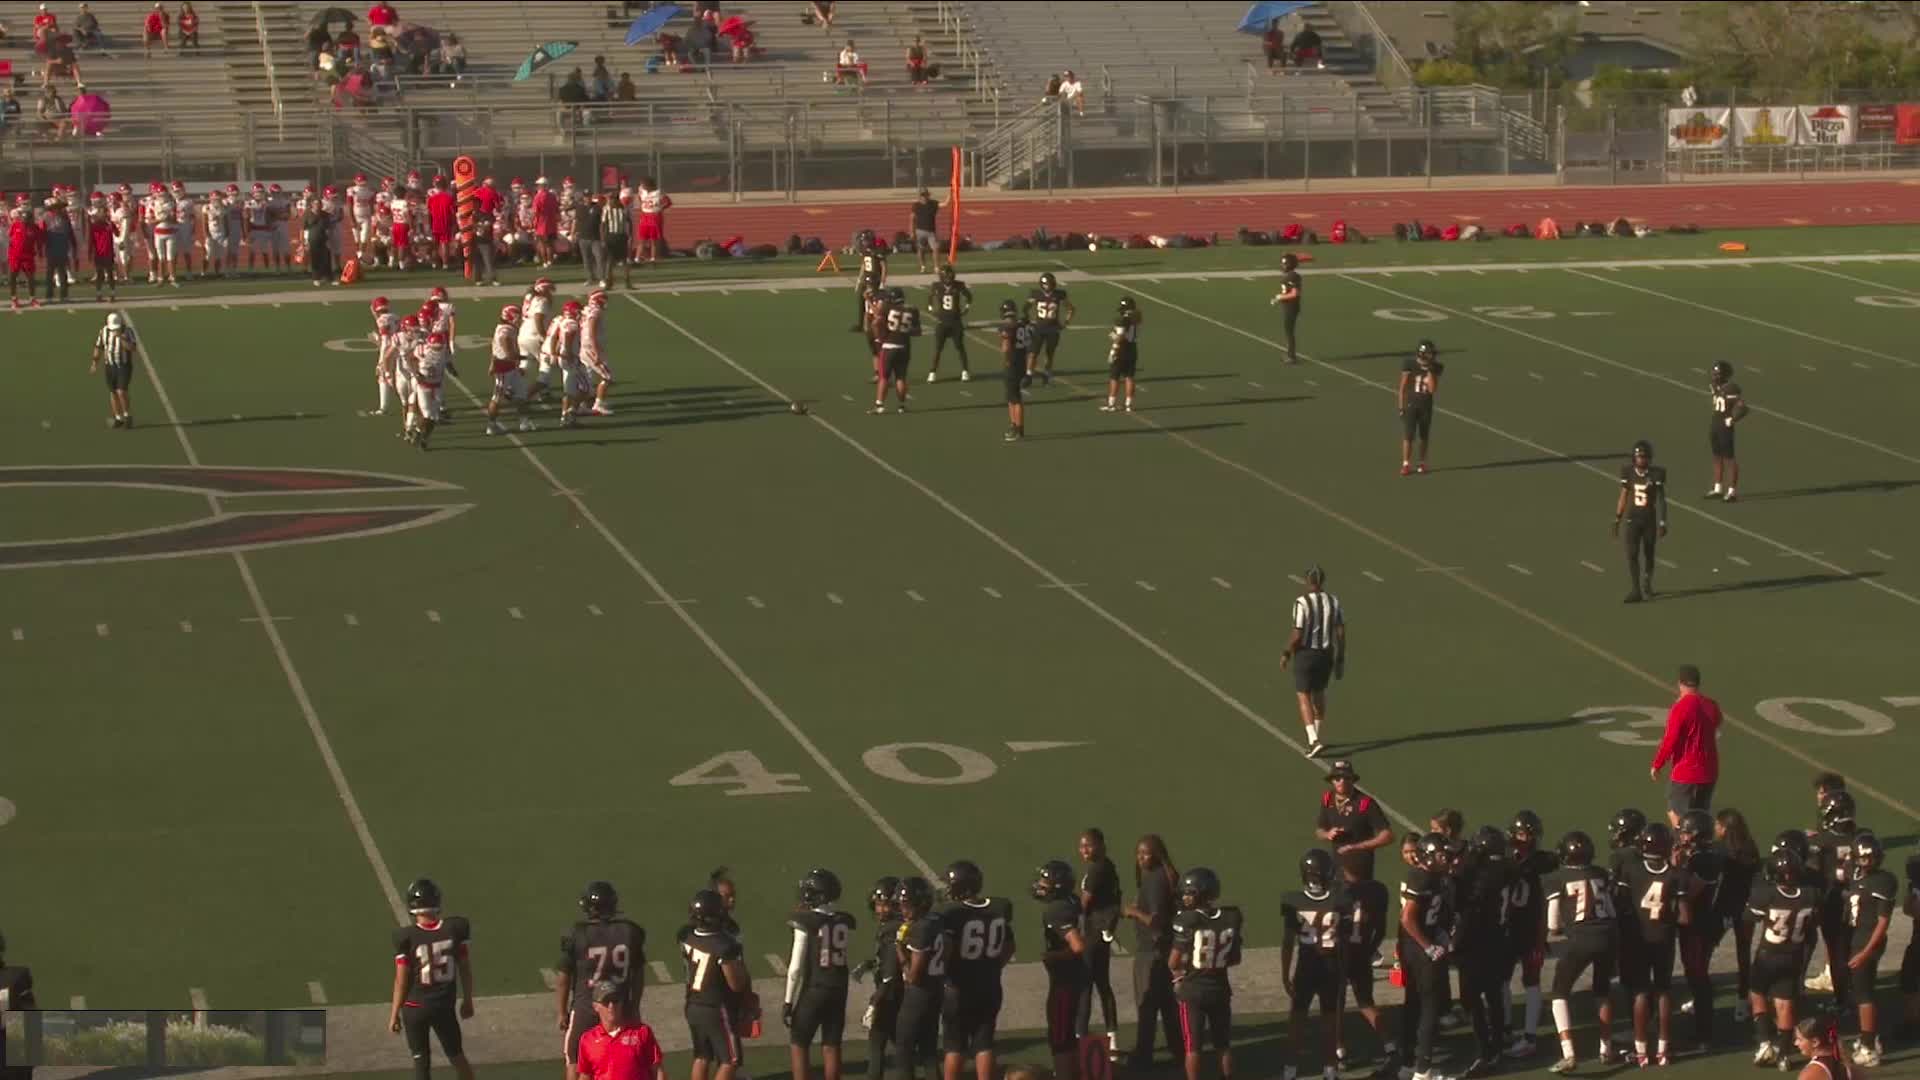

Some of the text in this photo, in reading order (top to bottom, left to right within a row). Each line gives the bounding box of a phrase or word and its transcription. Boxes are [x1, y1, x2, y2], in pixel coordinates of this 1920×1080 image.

[886, 308, 913, 332] 55
[1634, 484, 1648, 507] 5
[1640, 881, 1664, 920] 4
[818, 922, 850, 968] 19
[960, 917, 1005, 960] 60
[1192, 927, 1234, 969] 82
[414, 938, 454, 986] 15
[587, 943, 632, 986] 79
